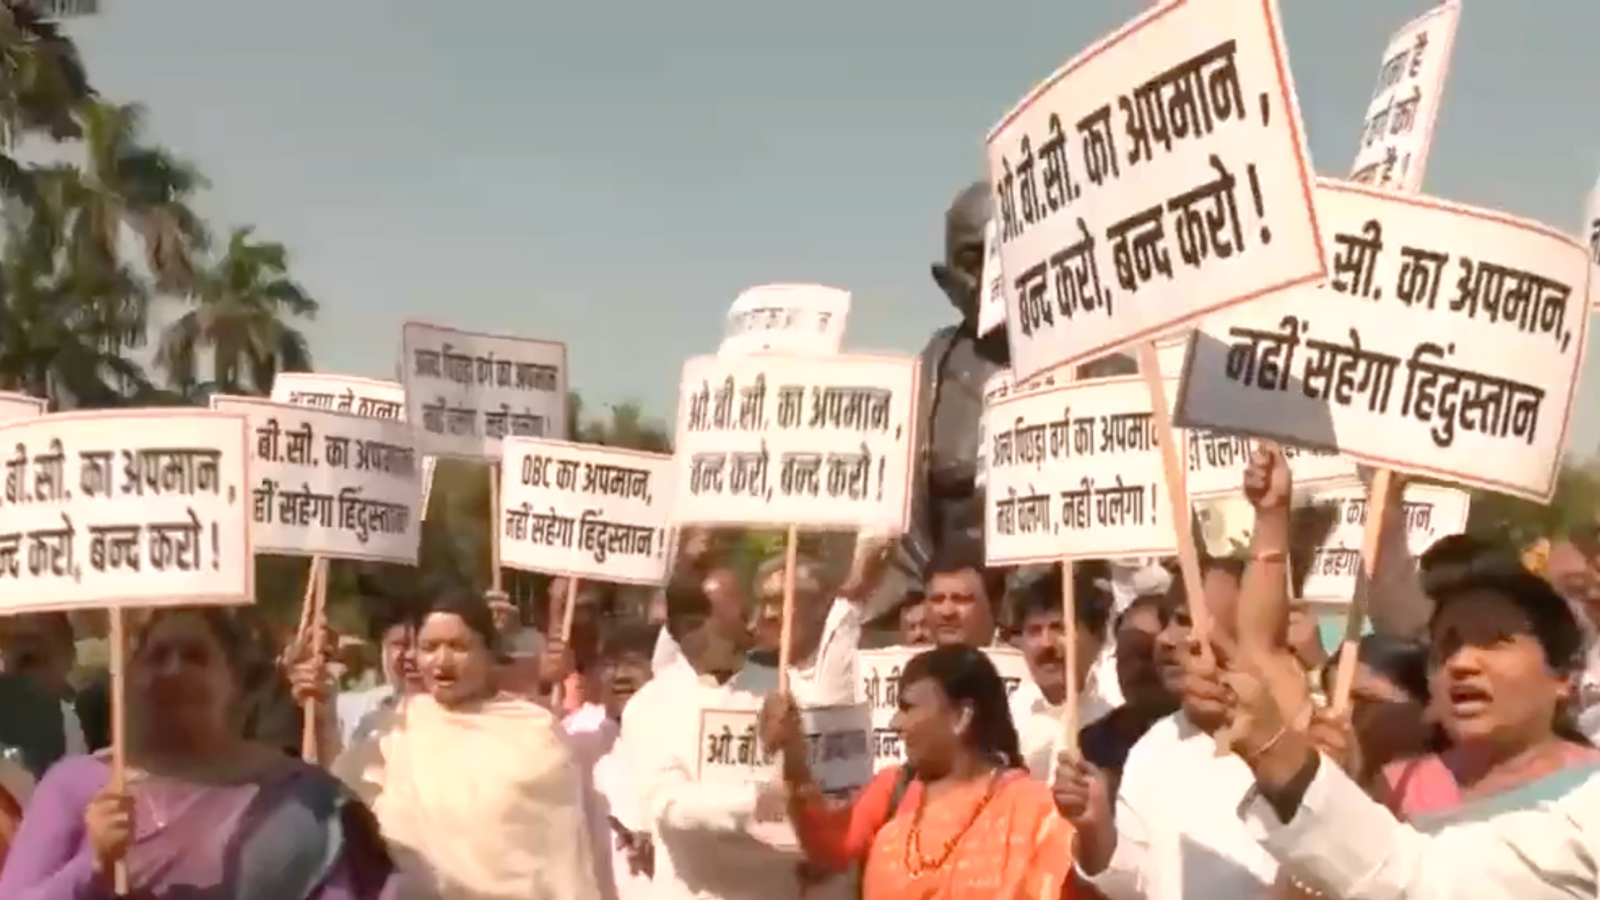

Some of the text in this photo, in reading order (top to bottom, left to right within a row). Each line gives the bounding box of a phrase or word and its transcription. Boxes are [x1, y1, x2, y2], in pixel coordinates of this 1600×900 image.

[1076, 104, 1119, 186] का
[1015, 262, 1054, 339] बन्द
[1050, 217, 1113, 317] करो,
[1106, 204, 1173, 293] बन्द
[1397, 245, 1448, 310] का
[1449, 256, 1573, 353] अपमान,
[777, 385, 805, 429] का
[1225, 316, 1546, 447] नहीं सहेगा हिंदुस्तान
[324, 435, 352, 469] का
[1049, 406, 1070, 461] वर्ग
[1073, 417, 1095, 456] का
[78, 450, 115, 499] का
[522, 455, 553, 488] OBC
[555, 459, 579, 492] का
[689, 451, 727, 496] बन्द
[729, 437, 773, 503] करो,
[781, 451, 823, 498] बन्द
[826, 441, 872, 500] करो
[252, 478, 280, 523] हीं
[278, 482, 334, 528] सहेगा
[1060, 475, 1095, 529] नहीं
[1094, 474, 1144, 527] चलेगा
[0, 532, 23, 579] न्द
[26, 510, 82, 585] करो,
[87, 523, 142, 573] बन्द
[146, 505, 203, 572] करो
[505, 502, 533, 542] नहीं
[531, 507, 576, 547] सहेगा
[578, 510, 655, 563] हिंदुस्तान
